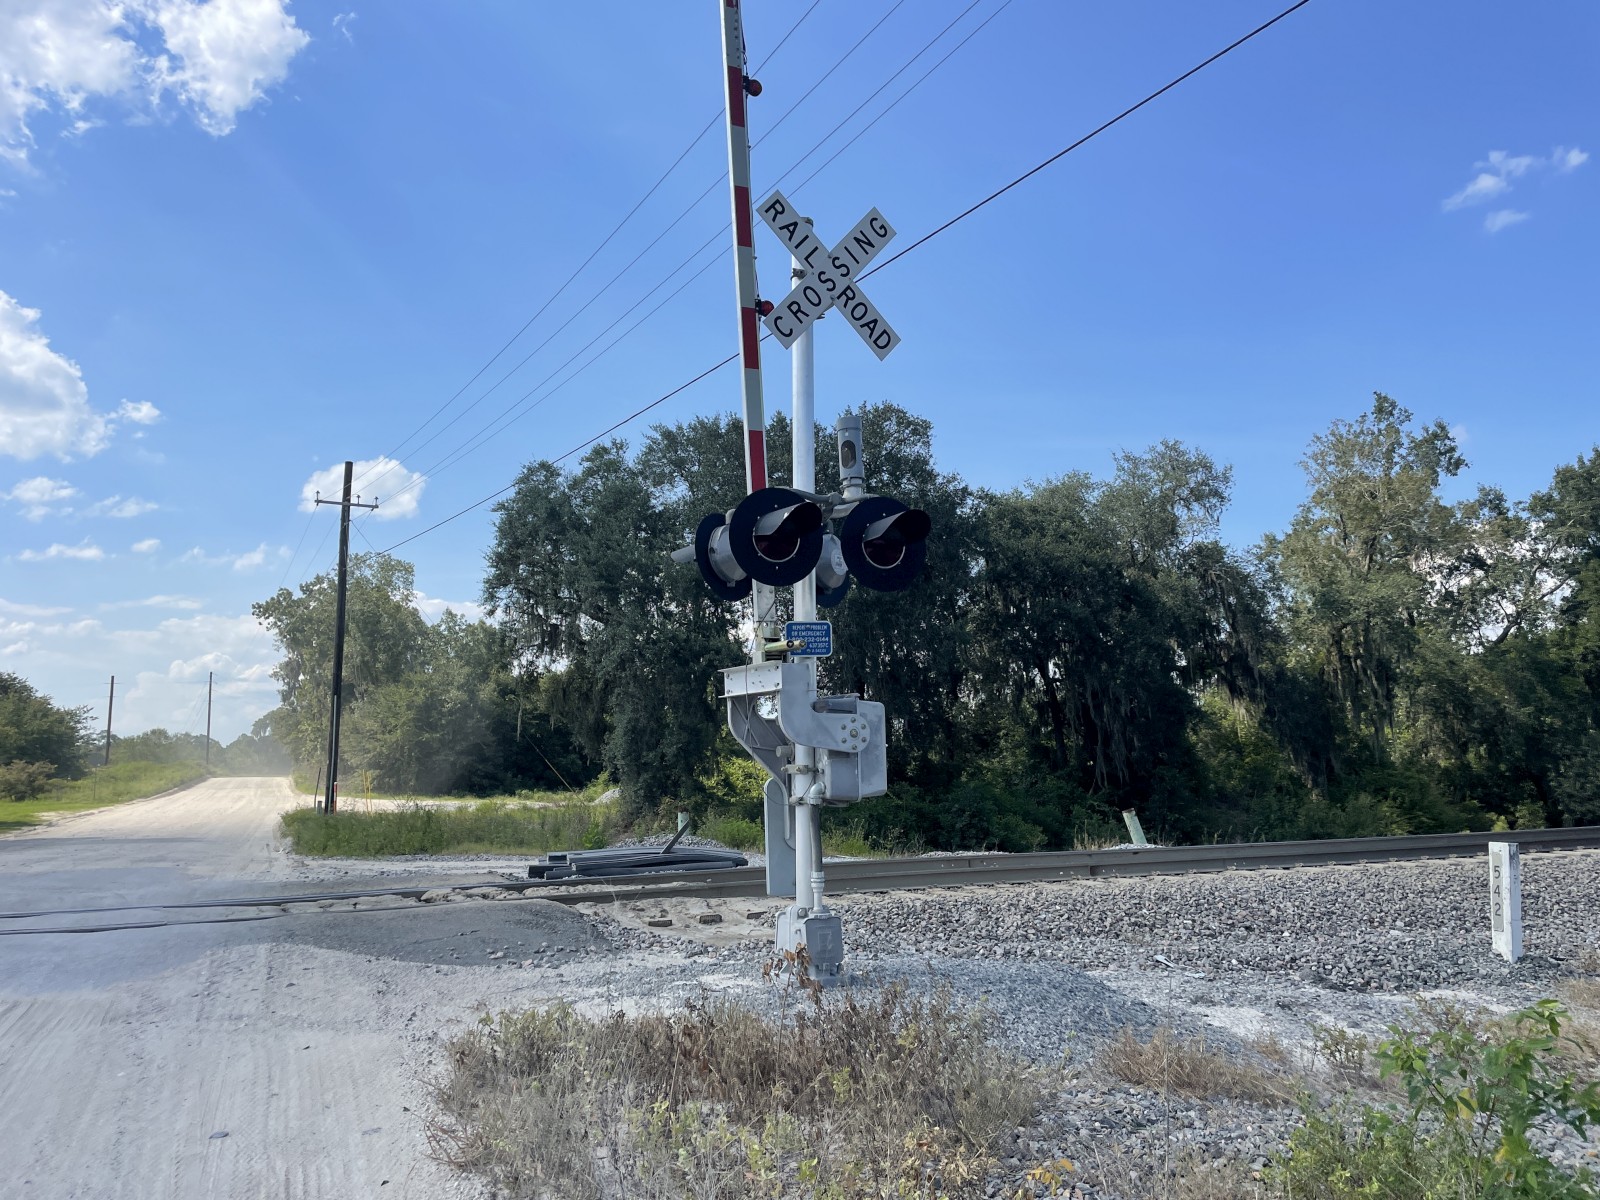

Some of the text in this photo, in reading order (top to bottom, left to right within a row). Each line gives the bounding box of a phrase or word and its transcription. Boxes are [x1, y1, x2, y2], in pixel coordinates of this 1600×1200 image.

[764, 198, 892, 350] RAIL ROAD
[773, 217, 888, 338] CROSSING
[1493, 865, 1501, 917] 542
